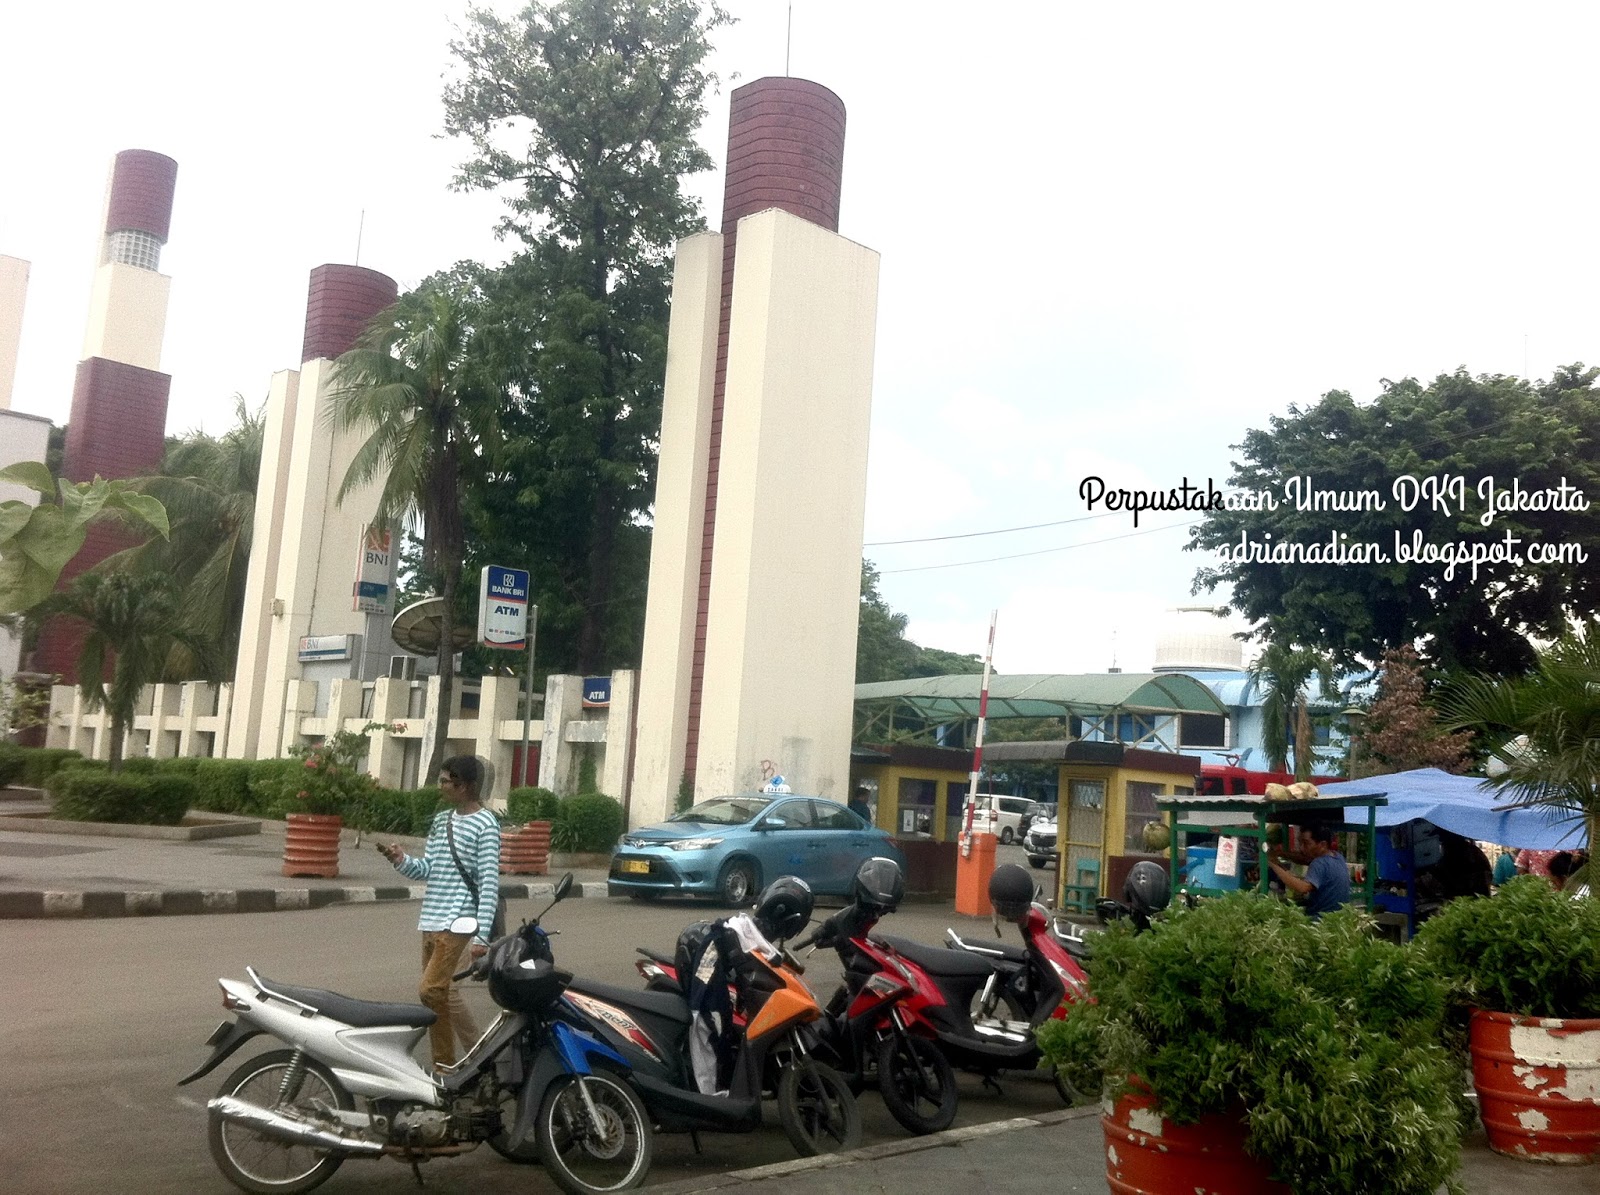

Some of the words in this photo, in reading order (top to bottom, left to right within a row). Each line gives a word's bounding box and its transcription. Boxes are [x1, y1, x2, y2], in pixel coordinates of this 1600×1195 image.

[366, 552, 389, 566] BNI
[491, 585, 512, 595] BANK
[512, 589, 525, 597] BRI
[494, 605, 519, 616] ATM
[588, 691, 605, 700] ATM
